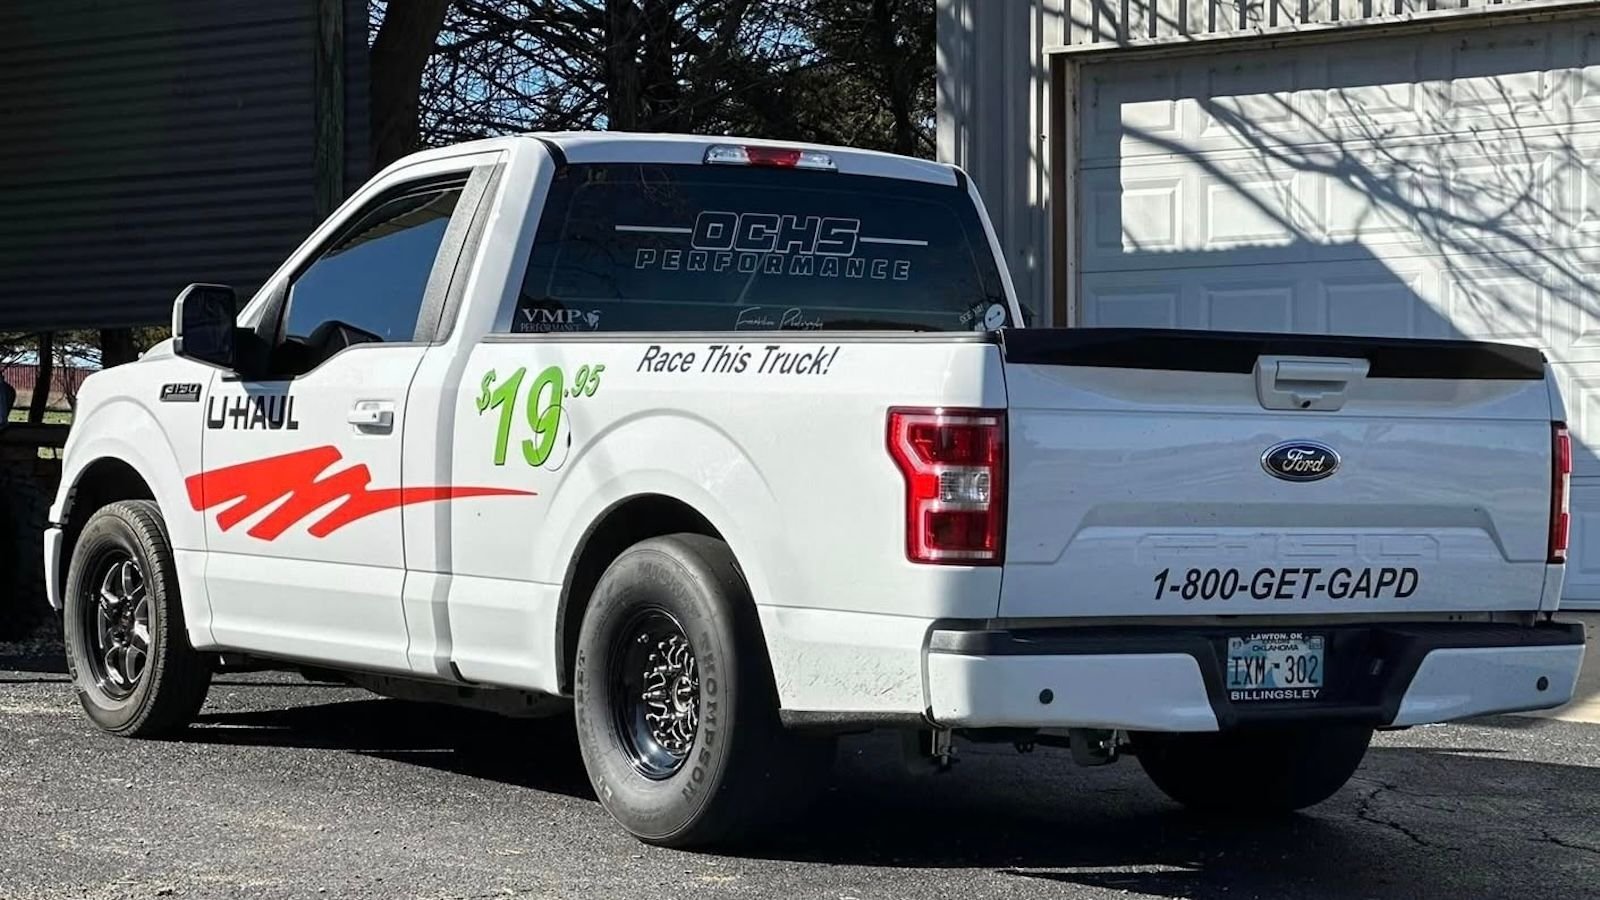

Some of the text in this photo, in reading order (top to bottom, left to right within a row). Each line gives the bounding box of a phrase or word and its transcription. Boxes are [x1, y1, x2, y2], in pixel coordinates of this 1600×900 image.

[691, 211, 860, 256] OCHS
[635, 249, 910, 280] PERFORMANCE
[522, 309, 581, 323] VMP
[637, 346, 840, 374] Race This Truck!
[1282, 448, 1325, 472] Ford
[1153, 567, 1419, 600] 1-800-GET-GAPD
[1252, 644, 1299, 652] OKLAHOMA
[1231, 655, 1319, 686] IXM 302
[1230, 689, 1320, 701] BILLINGSLEY
[682, 631, 718, 800] THOMPSON
